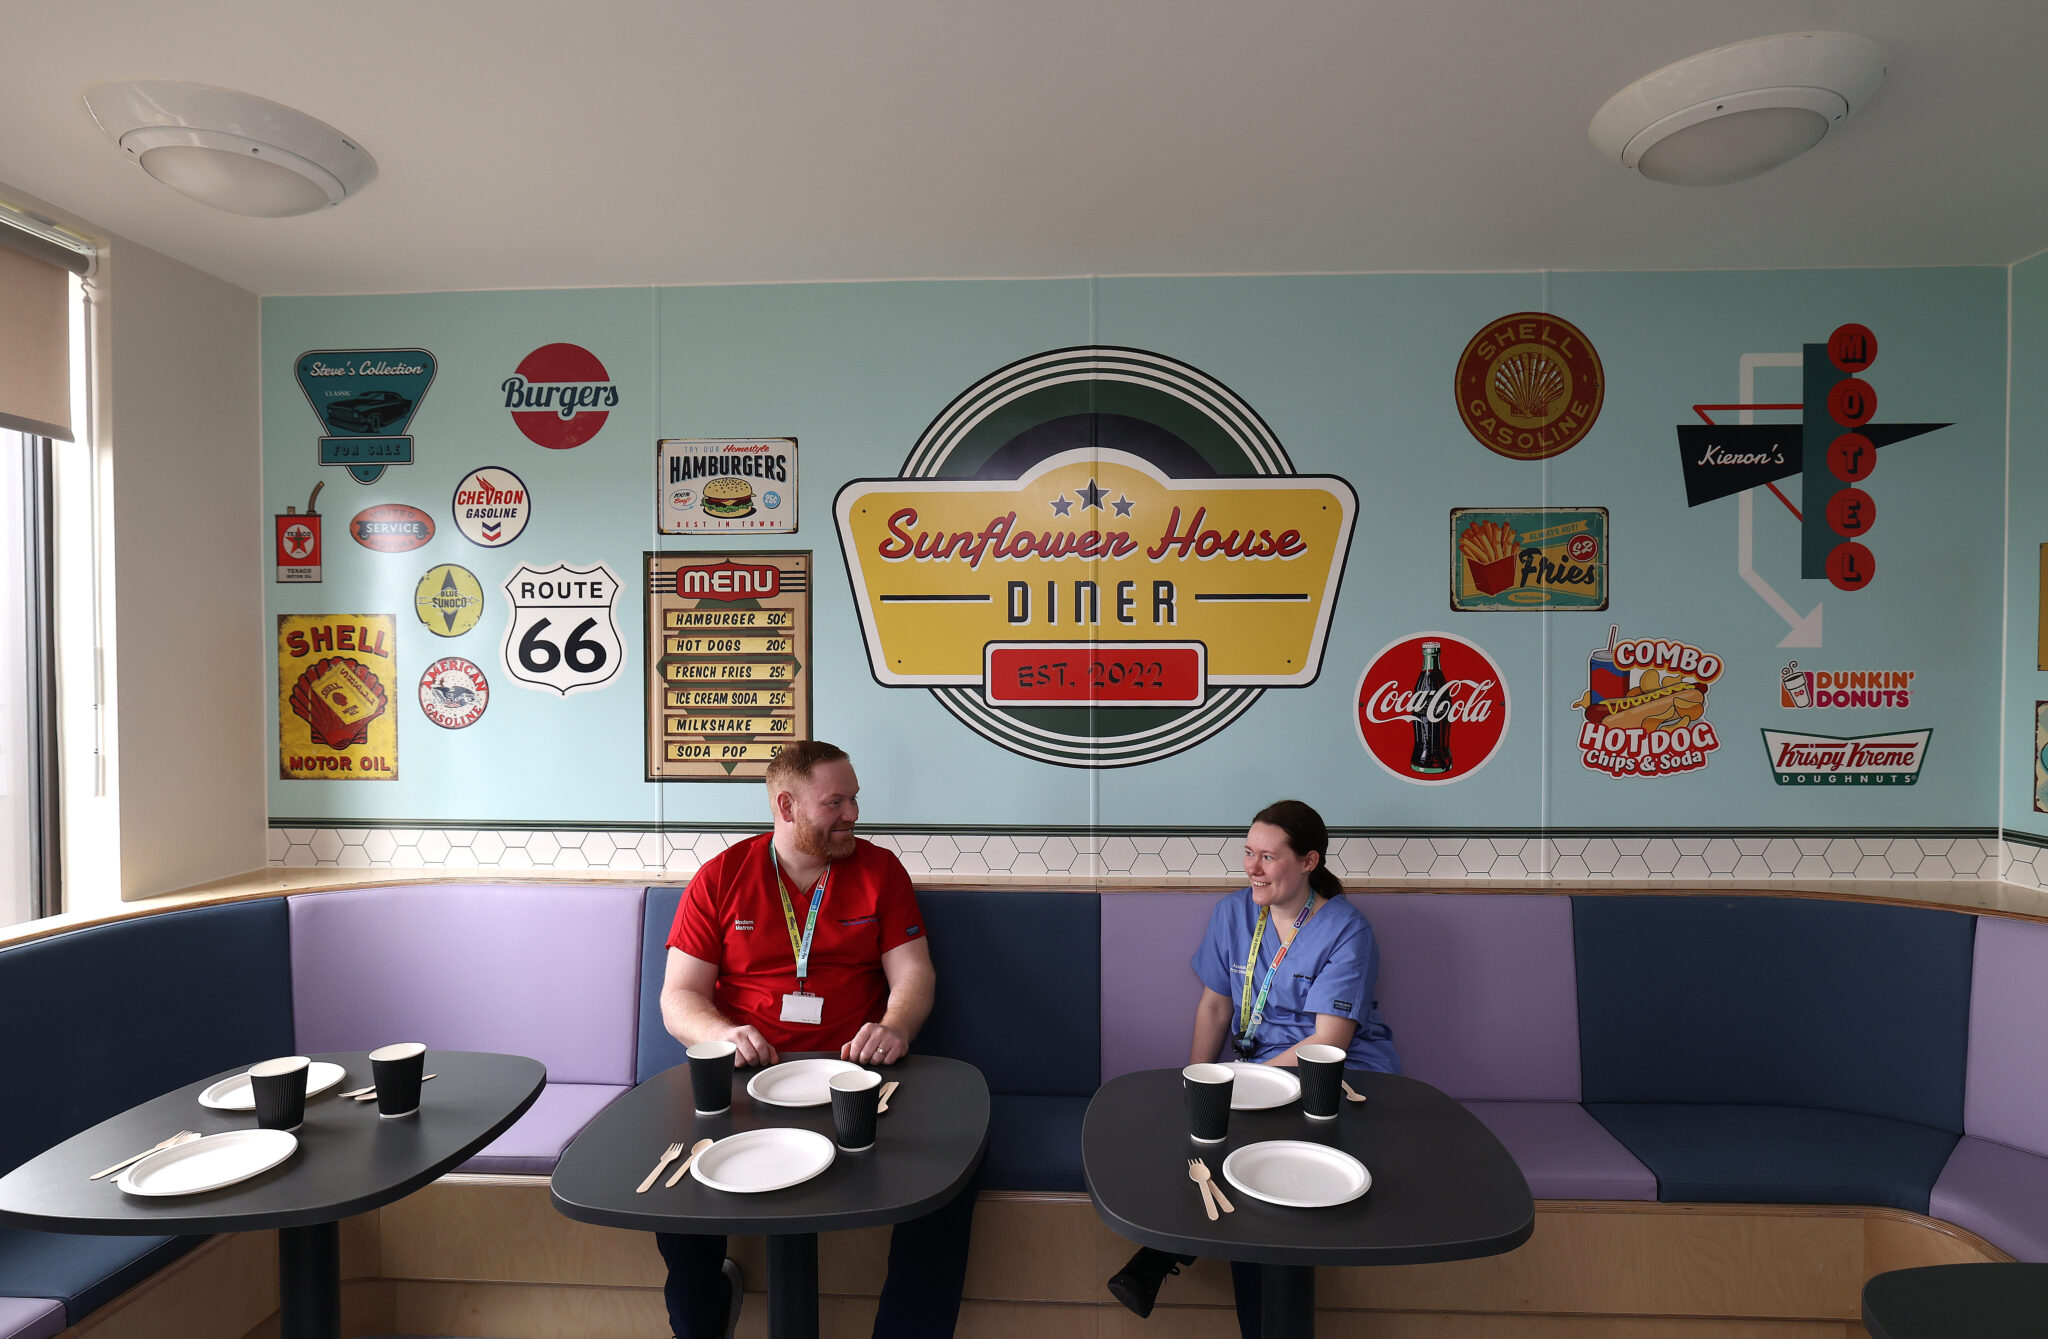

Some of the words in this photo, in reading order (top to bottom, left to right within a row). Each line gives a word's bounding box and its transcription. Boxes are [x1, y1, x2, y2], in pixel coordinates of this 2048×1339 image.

[1477, 323, 1574, 360] SHELL
[310, 361, 356, 377] Steve's
[359, 361, 424, 376] Collection
[501, 376, 619, 417] Burgers
[1470, 399, 1590, 449] GASOLINE
[333, 445, 359, 457] FOR
[367, 445, 401, 456] SALE
[684, 446, 699, 454] TRY
[722, 444, 770, 454] Homestyle
[1697, 444, 1785, 466] Kieron's
[1840, 334, 1867, 582] MOTEL
[669, 455, 787, 484] HAMBURGERS
[457, 489, 523, 506] CHEVRON
[371, 508, 415, 519] UNITED
[466, 508, 518, 520] GASOLINE
[366, 523, 419, 533] SERVICE
[878, 507, 1138, 571] Sunflower
[1146, 506, 1308, 563] House
[1518, 547, 1595, 588] Fries
[521, 581, 604, 599] ROUTE
[684, 570, 773, 593] MENU
[432, 597, 467, 608] SUNOCO
[1007, 580, 1178, 626] DINER
[675, 613, 756, 626] HAMBURGER
[766, 613, 787, 625] 50¢
[286, 625, 389, 659] SHELL
[518, 617, 607, 673] 66
[676, 639, 702, 652] HOT
[707, 639, 742, 651] DOGS
[766, 639, 786, 651] 20¢
[1616, 641, 1719, 678] COMBO
[421, 659, 488, 692] AMERICAN
[675, 666, 716, 678] FRENCH
[721, 666, 752, 678] FRIES
[769, 666, 786, 678] 25¢
[1016, 662, 1077, 689] EST.
[1089, 662, 1164, 689] 2022
[1816, 671, 1915, 689] DUNKIN'
[675, 692, 691, 705] ICE
[693, 692, 729, 705] CREAM
[731, 692, 758, 705] SODA
[768, 692, 786, 704] 25¢
[1366, 679, 1496, 724] Coca-Cola
[1816, 690, 1910, 708] DONUTS
[425, 703, 482, 727] GASOLINE
[676, 719, 752, 731] MILKSHAKE
[770, 719, 788, 731] 20¢
[1582, 722, 1644, 753] HOT
[1651, 723, 1715, 754] DOG
[677, 745, 711, 758] SODA
[721, 745, 748, 758] POP
[1586, 749, 1636, 773] Chips
[1639, 756, 1657, 772] &
[1659, 751, 1703, 770] Soda
[1776, 742, 1849, 772] Krispy
[1846, 742, 1920, 768] Kreme
[289, 756, 353, 771] MOTOR
[359, 756, 391, 771] OIL
